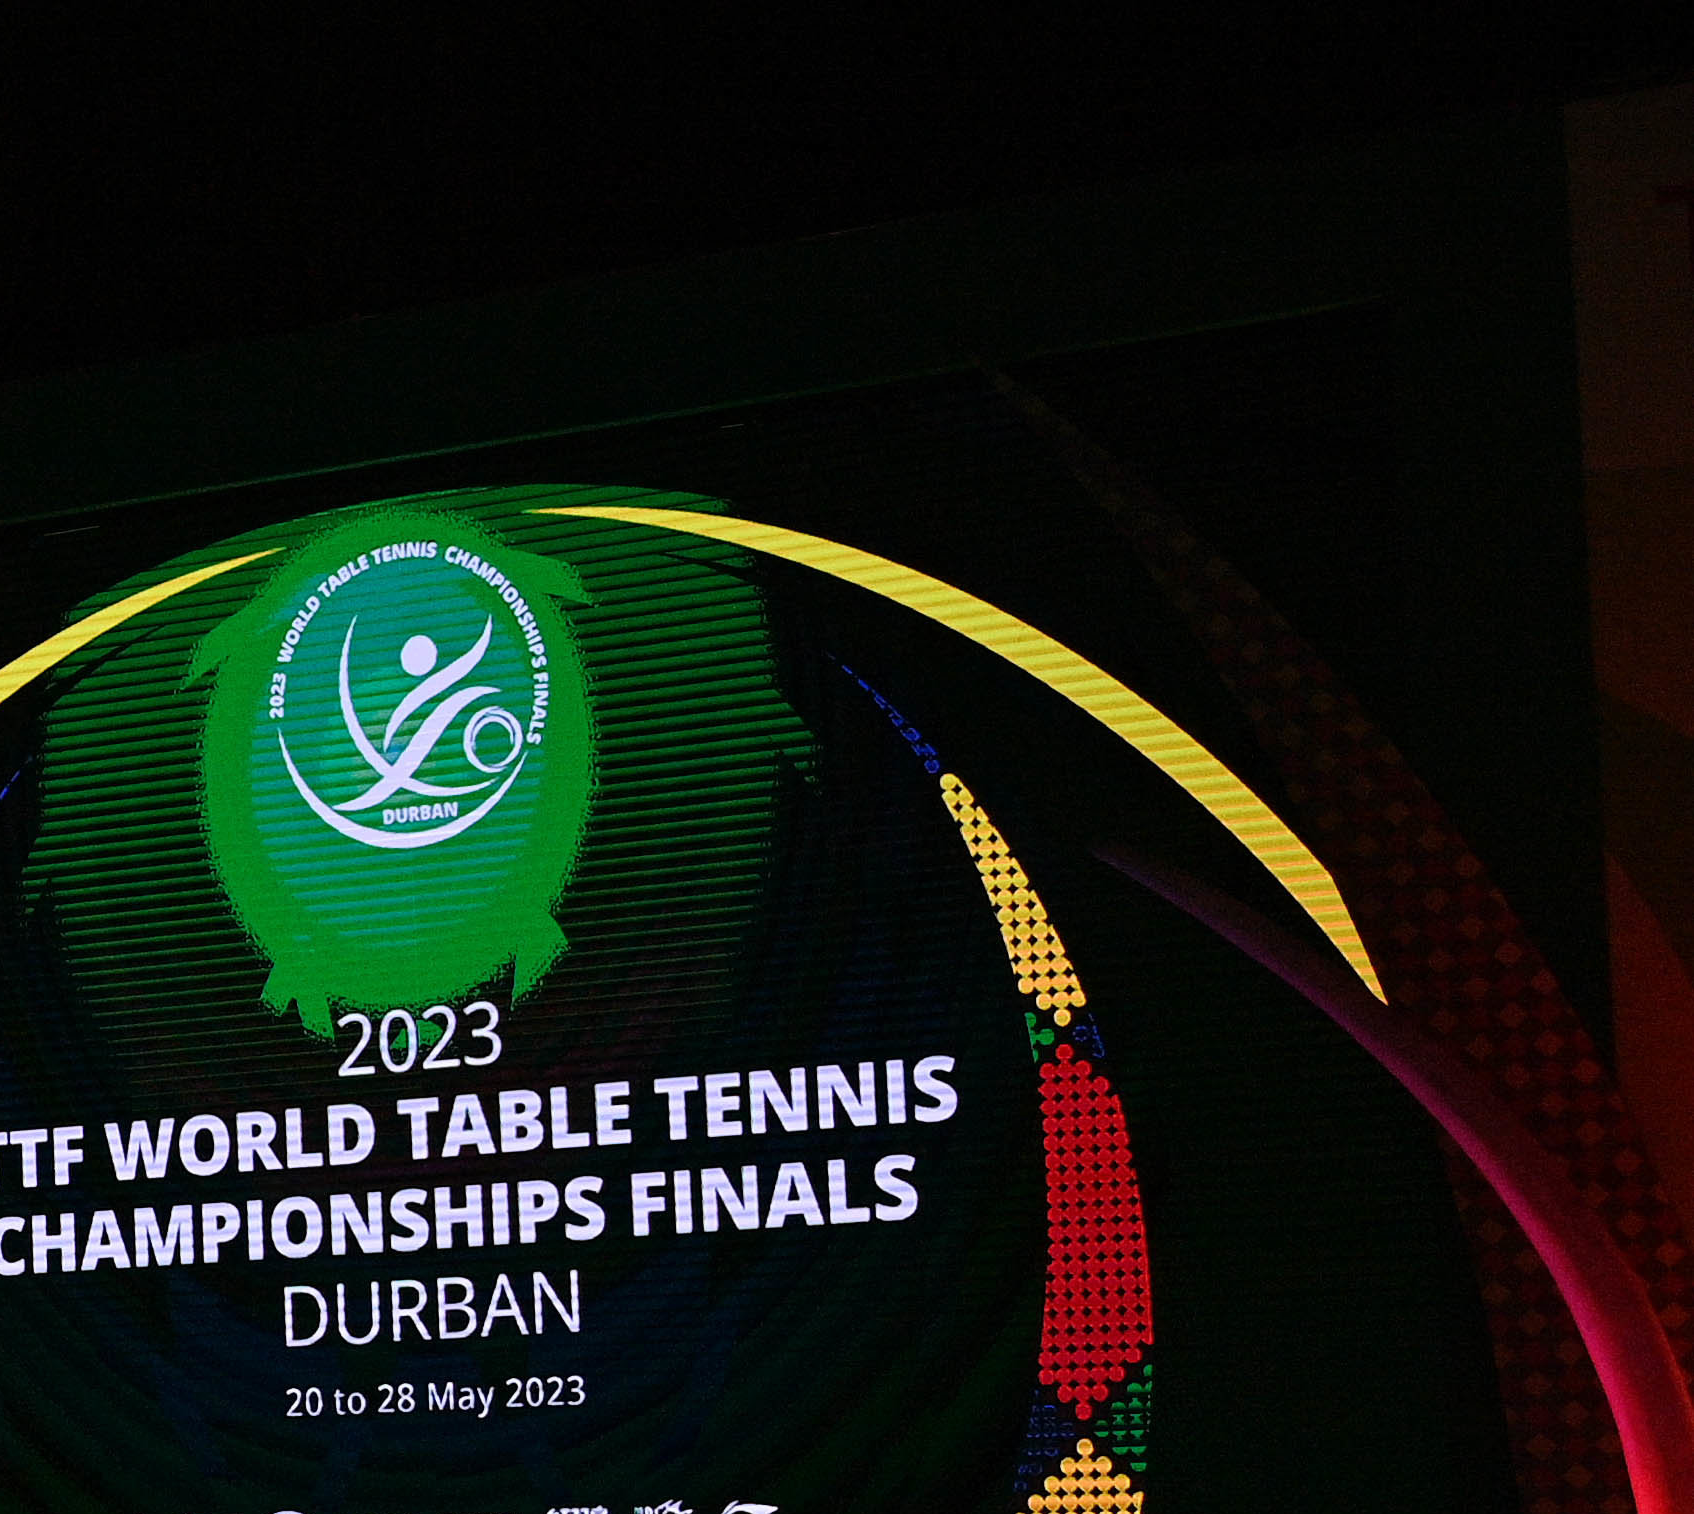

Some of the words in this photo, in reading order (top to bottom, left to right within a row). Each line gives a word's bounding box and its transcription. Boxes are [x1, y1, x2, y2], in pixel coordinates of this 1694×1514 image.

[318, 554, 369, 598] TABLE
[370, 541, 437, 565] TENNIS
[277, 596, 321, 663] WORLD
[445, 546, 547, 667] CHAMPIONSHIPS
[269, 673, 287, 718] 2023
[526, 672, 548, 745] FINALS
[382, 801, 459, 825] DURBAN
[336, 1001, 503, 1077] 2023
[105, 1104, 374, 1182] WORLD
[397, 1082, 630, 1163] TABLE
[653, 1054, 958, 1143] TENNIS
[630, 1155, 917, 1237] FINALS
[284, 1270, 581, 1348] DURBAN
[285, 1387, 325, 1418] 20
[333, 1385, 366, 1416] to
[375, 1383, 415, 1415] 28
[427, 1381, 493, 1418] May
[505, 1376, 586, 1410] 2023
